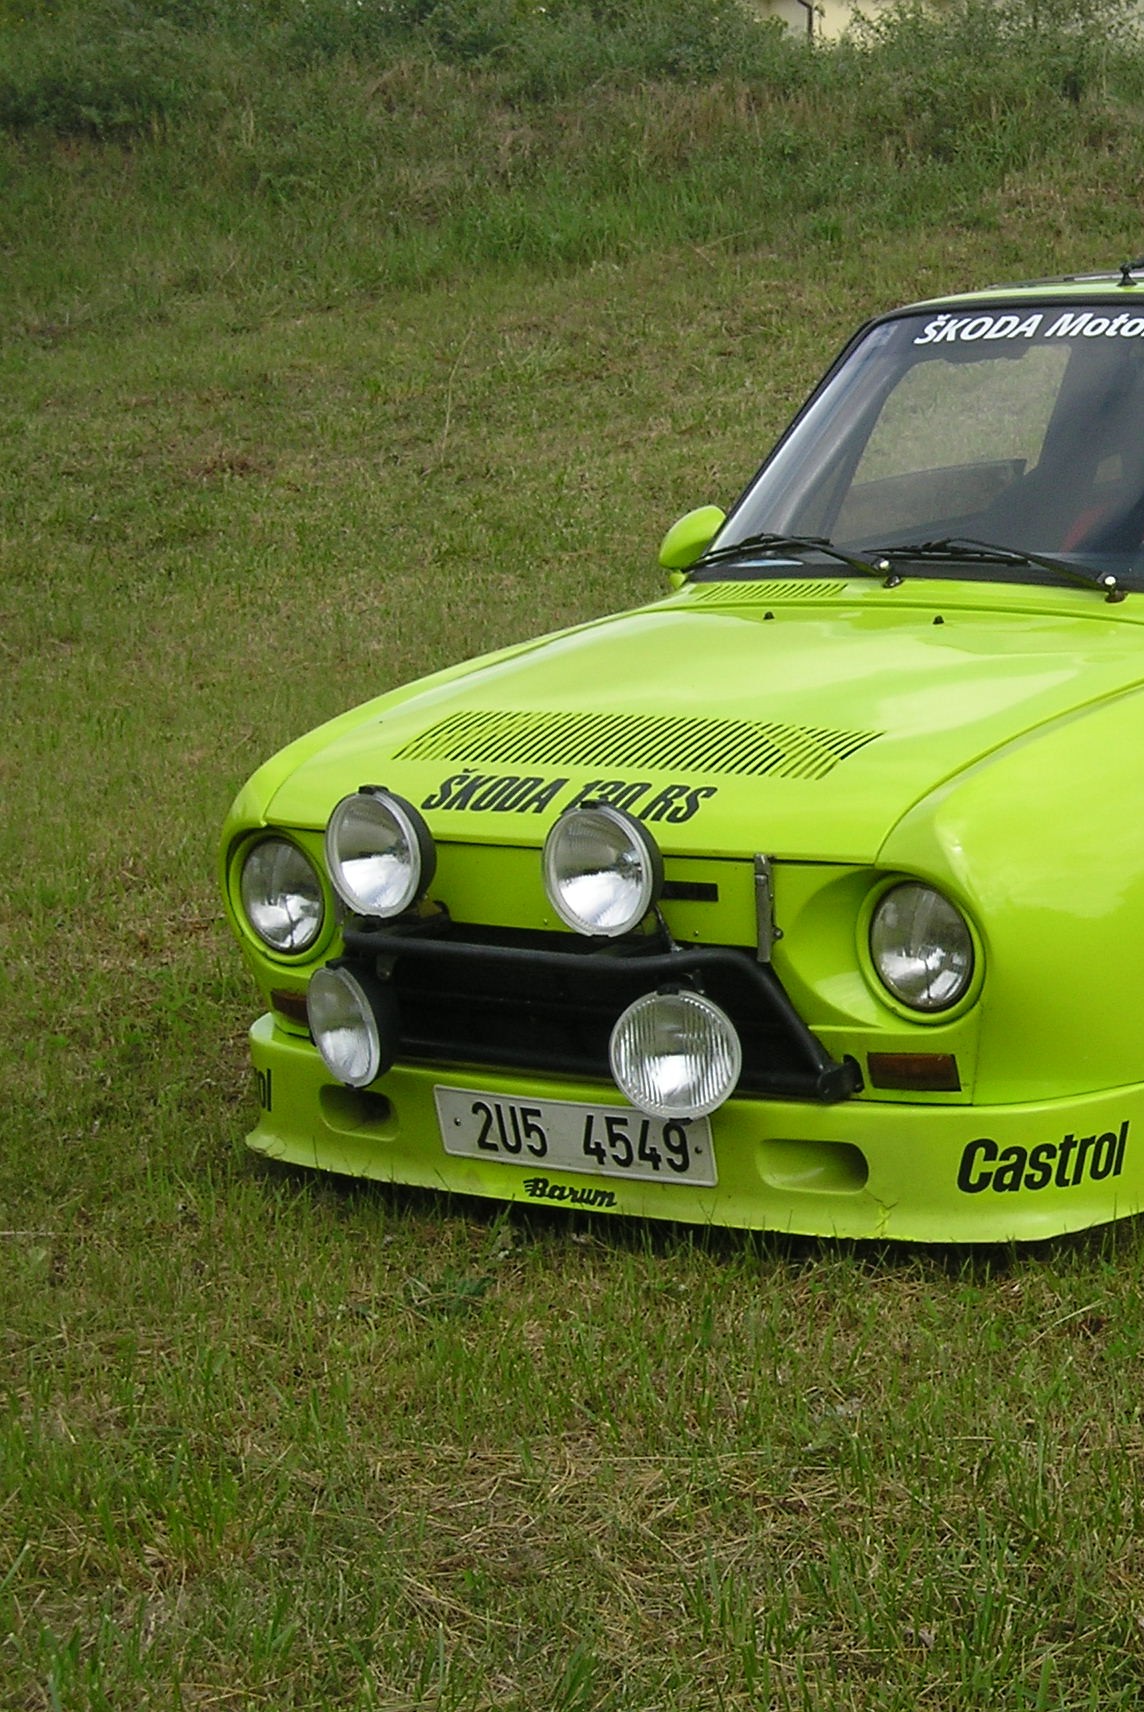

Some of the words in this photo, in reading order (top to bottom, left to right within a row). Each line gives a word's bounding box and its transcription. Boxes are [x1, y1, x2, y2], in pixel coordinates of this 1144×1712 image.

[913, 313, 1043, 345] ŠKODA
[421, 768, 570, 814] ŠKODA
[639, 784, 718, 824] RS
[472, 1101, 548, 1157] 2U5
[583, 1113, 690, 1173] 4549
[956, 1120, 1130, 1194] Castrol
[523, 1177, 618, 1208] Barum
